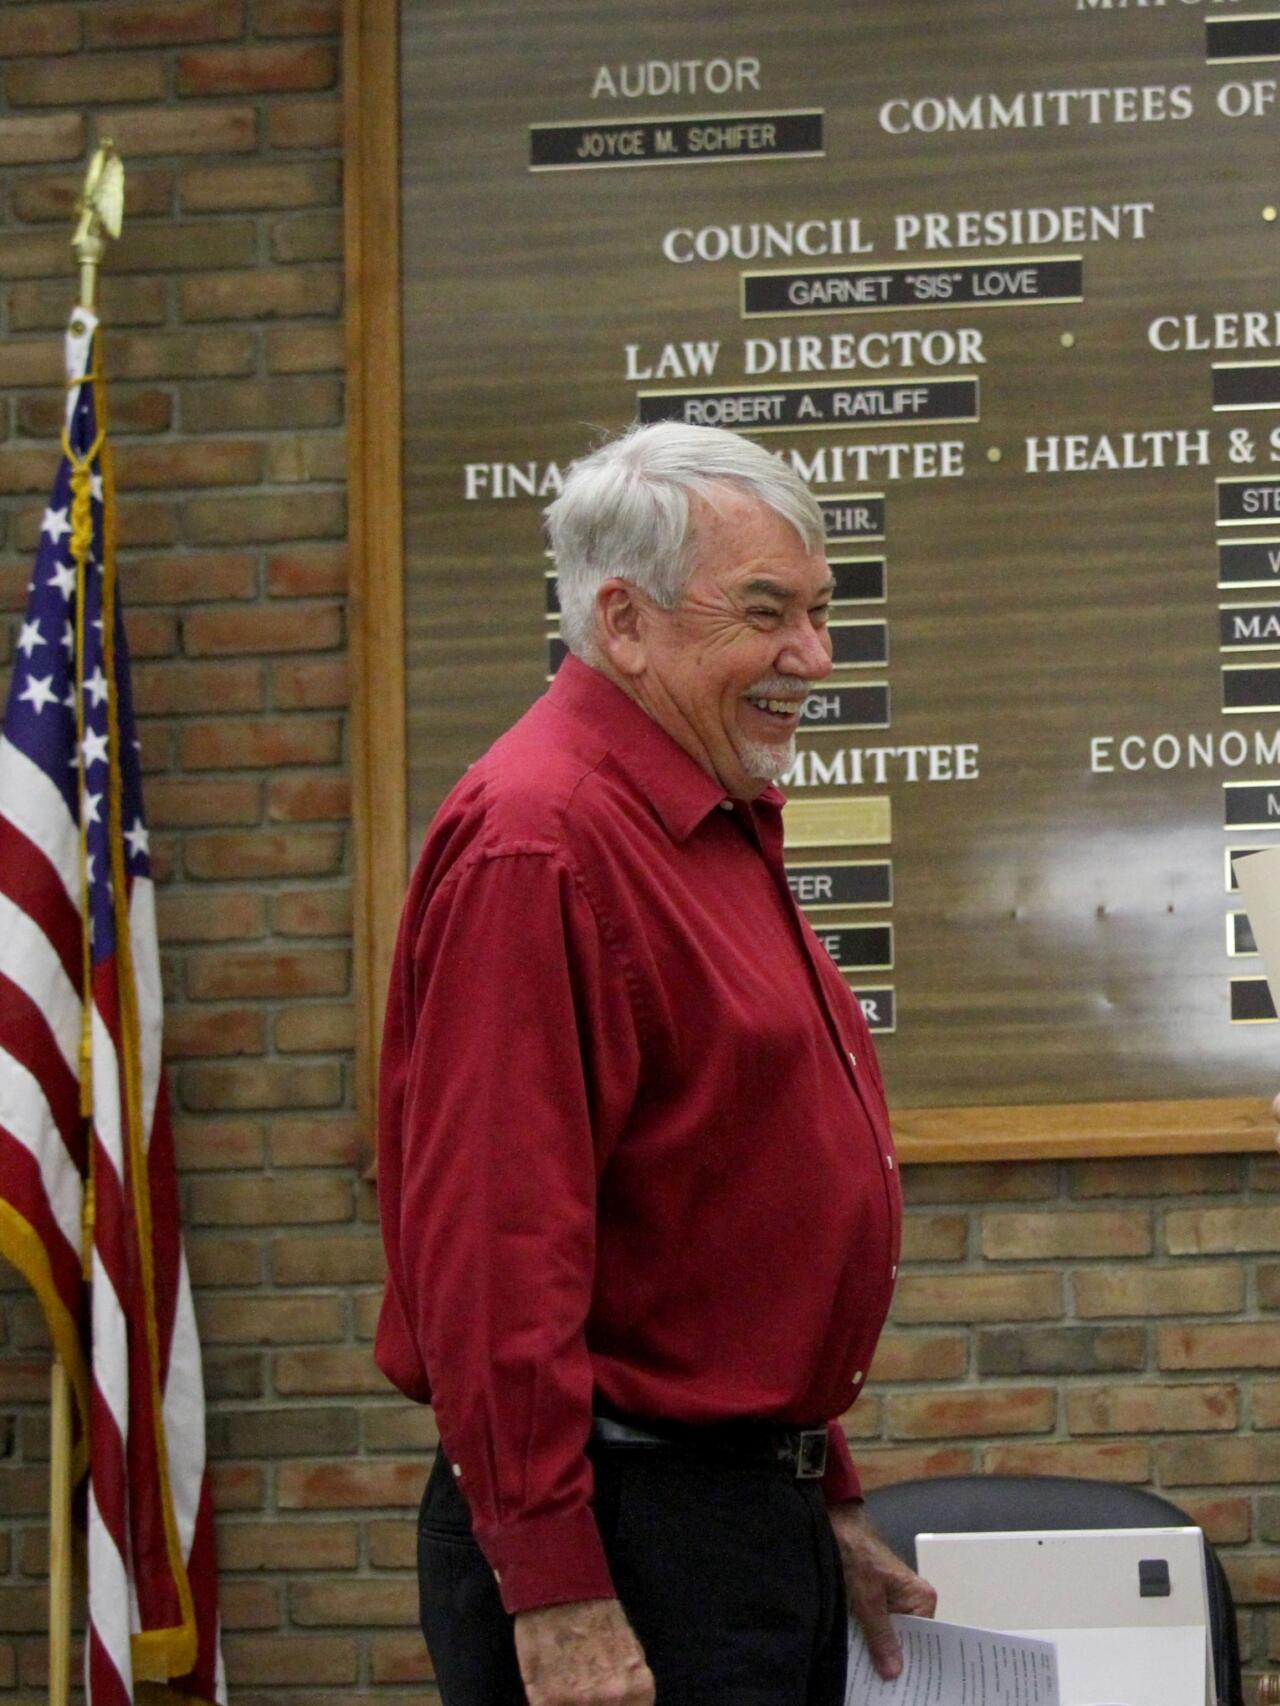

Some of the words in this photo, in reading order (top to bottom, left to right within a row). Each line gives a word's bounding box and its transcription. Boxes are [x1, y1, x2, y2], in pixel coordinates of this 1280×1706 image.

[591, 56, 761, 98] AUDITOR
[878, 85, 1194, 135] COMMITTEES
[1217, 80, 1277, 117] OF
[576, 128, 647, 158] JOYCE
[686, 122, 777, 152] SCHIFER
[662, 217, 873, 264] COUNCIL
[894, 202, 1156, 252] PRESIDENT
[787, 276, 893, 306] GARNET
[903, 273, 963, 299] "SIS"
[972, 269, 1039, 297] LOVE
[624, 341, 721, 380] LAW
[744, 328, 987, 375] DIRECTOR
[684, 395, 786, 424] ROBERT
[797, 396, 823, 419] A.
[832, 388, 928, 418] RATLIFF
[464, 461, 563, 500] FINA
[790, 441, 965, 483] MITTEE
[1025, 430, 1212, 473] HEALTH
[1229, 428, 1255, 464] &
[778, 744, 980, 787] MMITTEE
